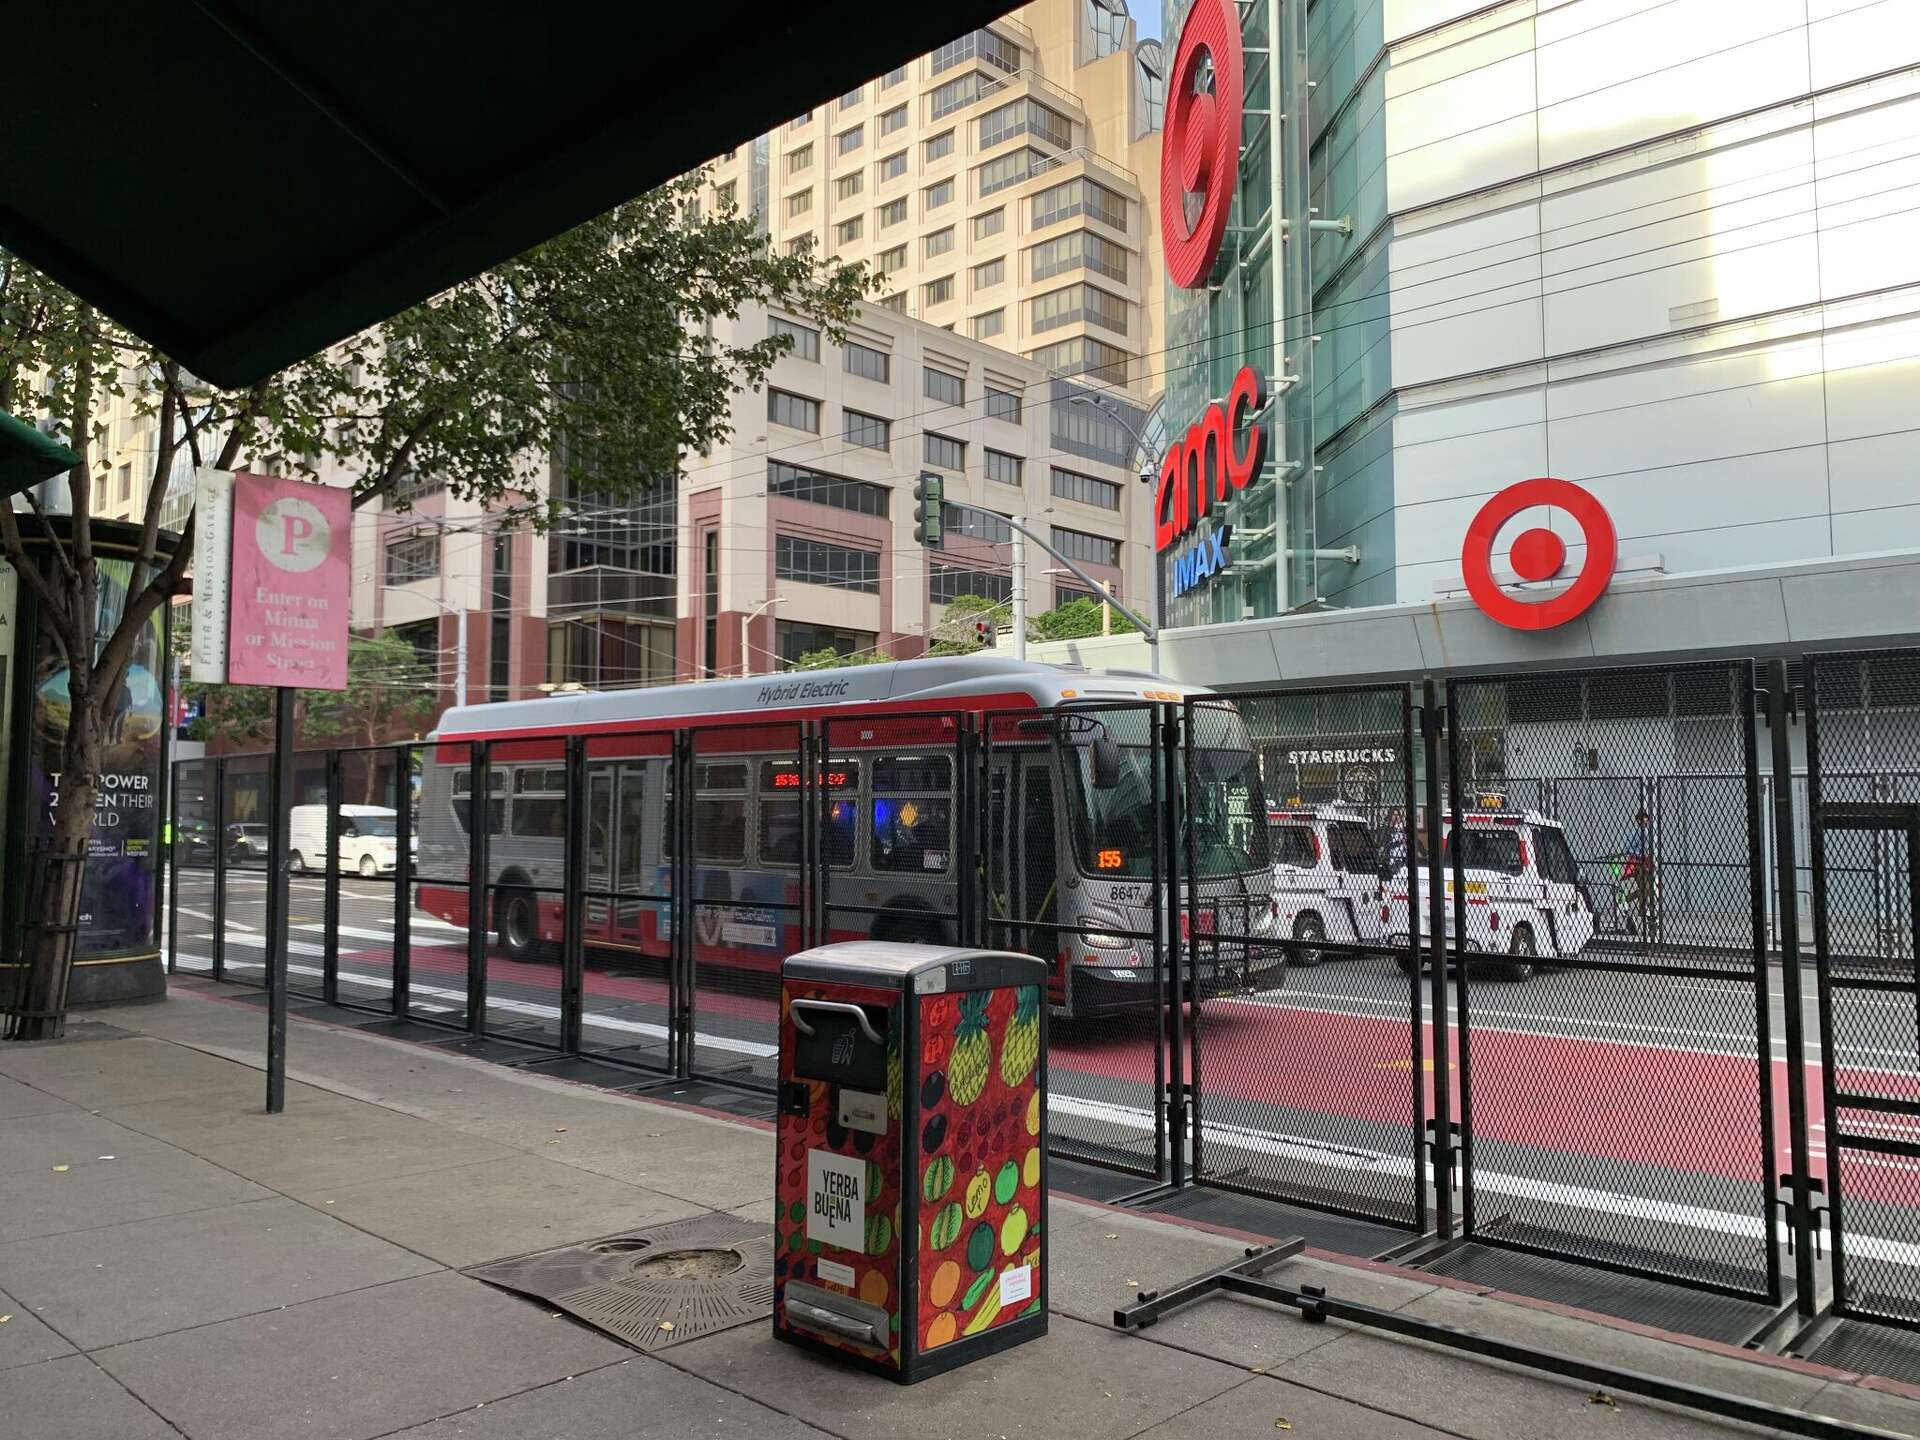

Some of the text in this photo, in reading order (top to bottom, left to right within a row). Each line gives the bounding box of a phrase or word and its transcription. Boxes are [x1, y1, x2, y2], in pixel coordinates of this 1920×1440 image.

[204, 487, 218, 541] GARAGE
[281, 514, 313, 556] P
[202, 545, 215, 602] MISSION
[1174, 526, 1230, 598] IMAX
[256, 586, 329, 609] Enter on
[202, 610, 213, 619] &
[265, 610, 320, 629] Minna
[245, 631, 336, 651] or Mission
[757, 678, 849, 705] Hybrid Electric
[1288, 748, 1396, 764] STARBUCKS
[120, 794, 153, 808] THEIR
[1098, 850, 1121, 868] 155
[1110, 886, 1140, 900] 8647
[823, 1169, 859, 1200] YERBA
[815, 1191, 851, 1228] BUENA
